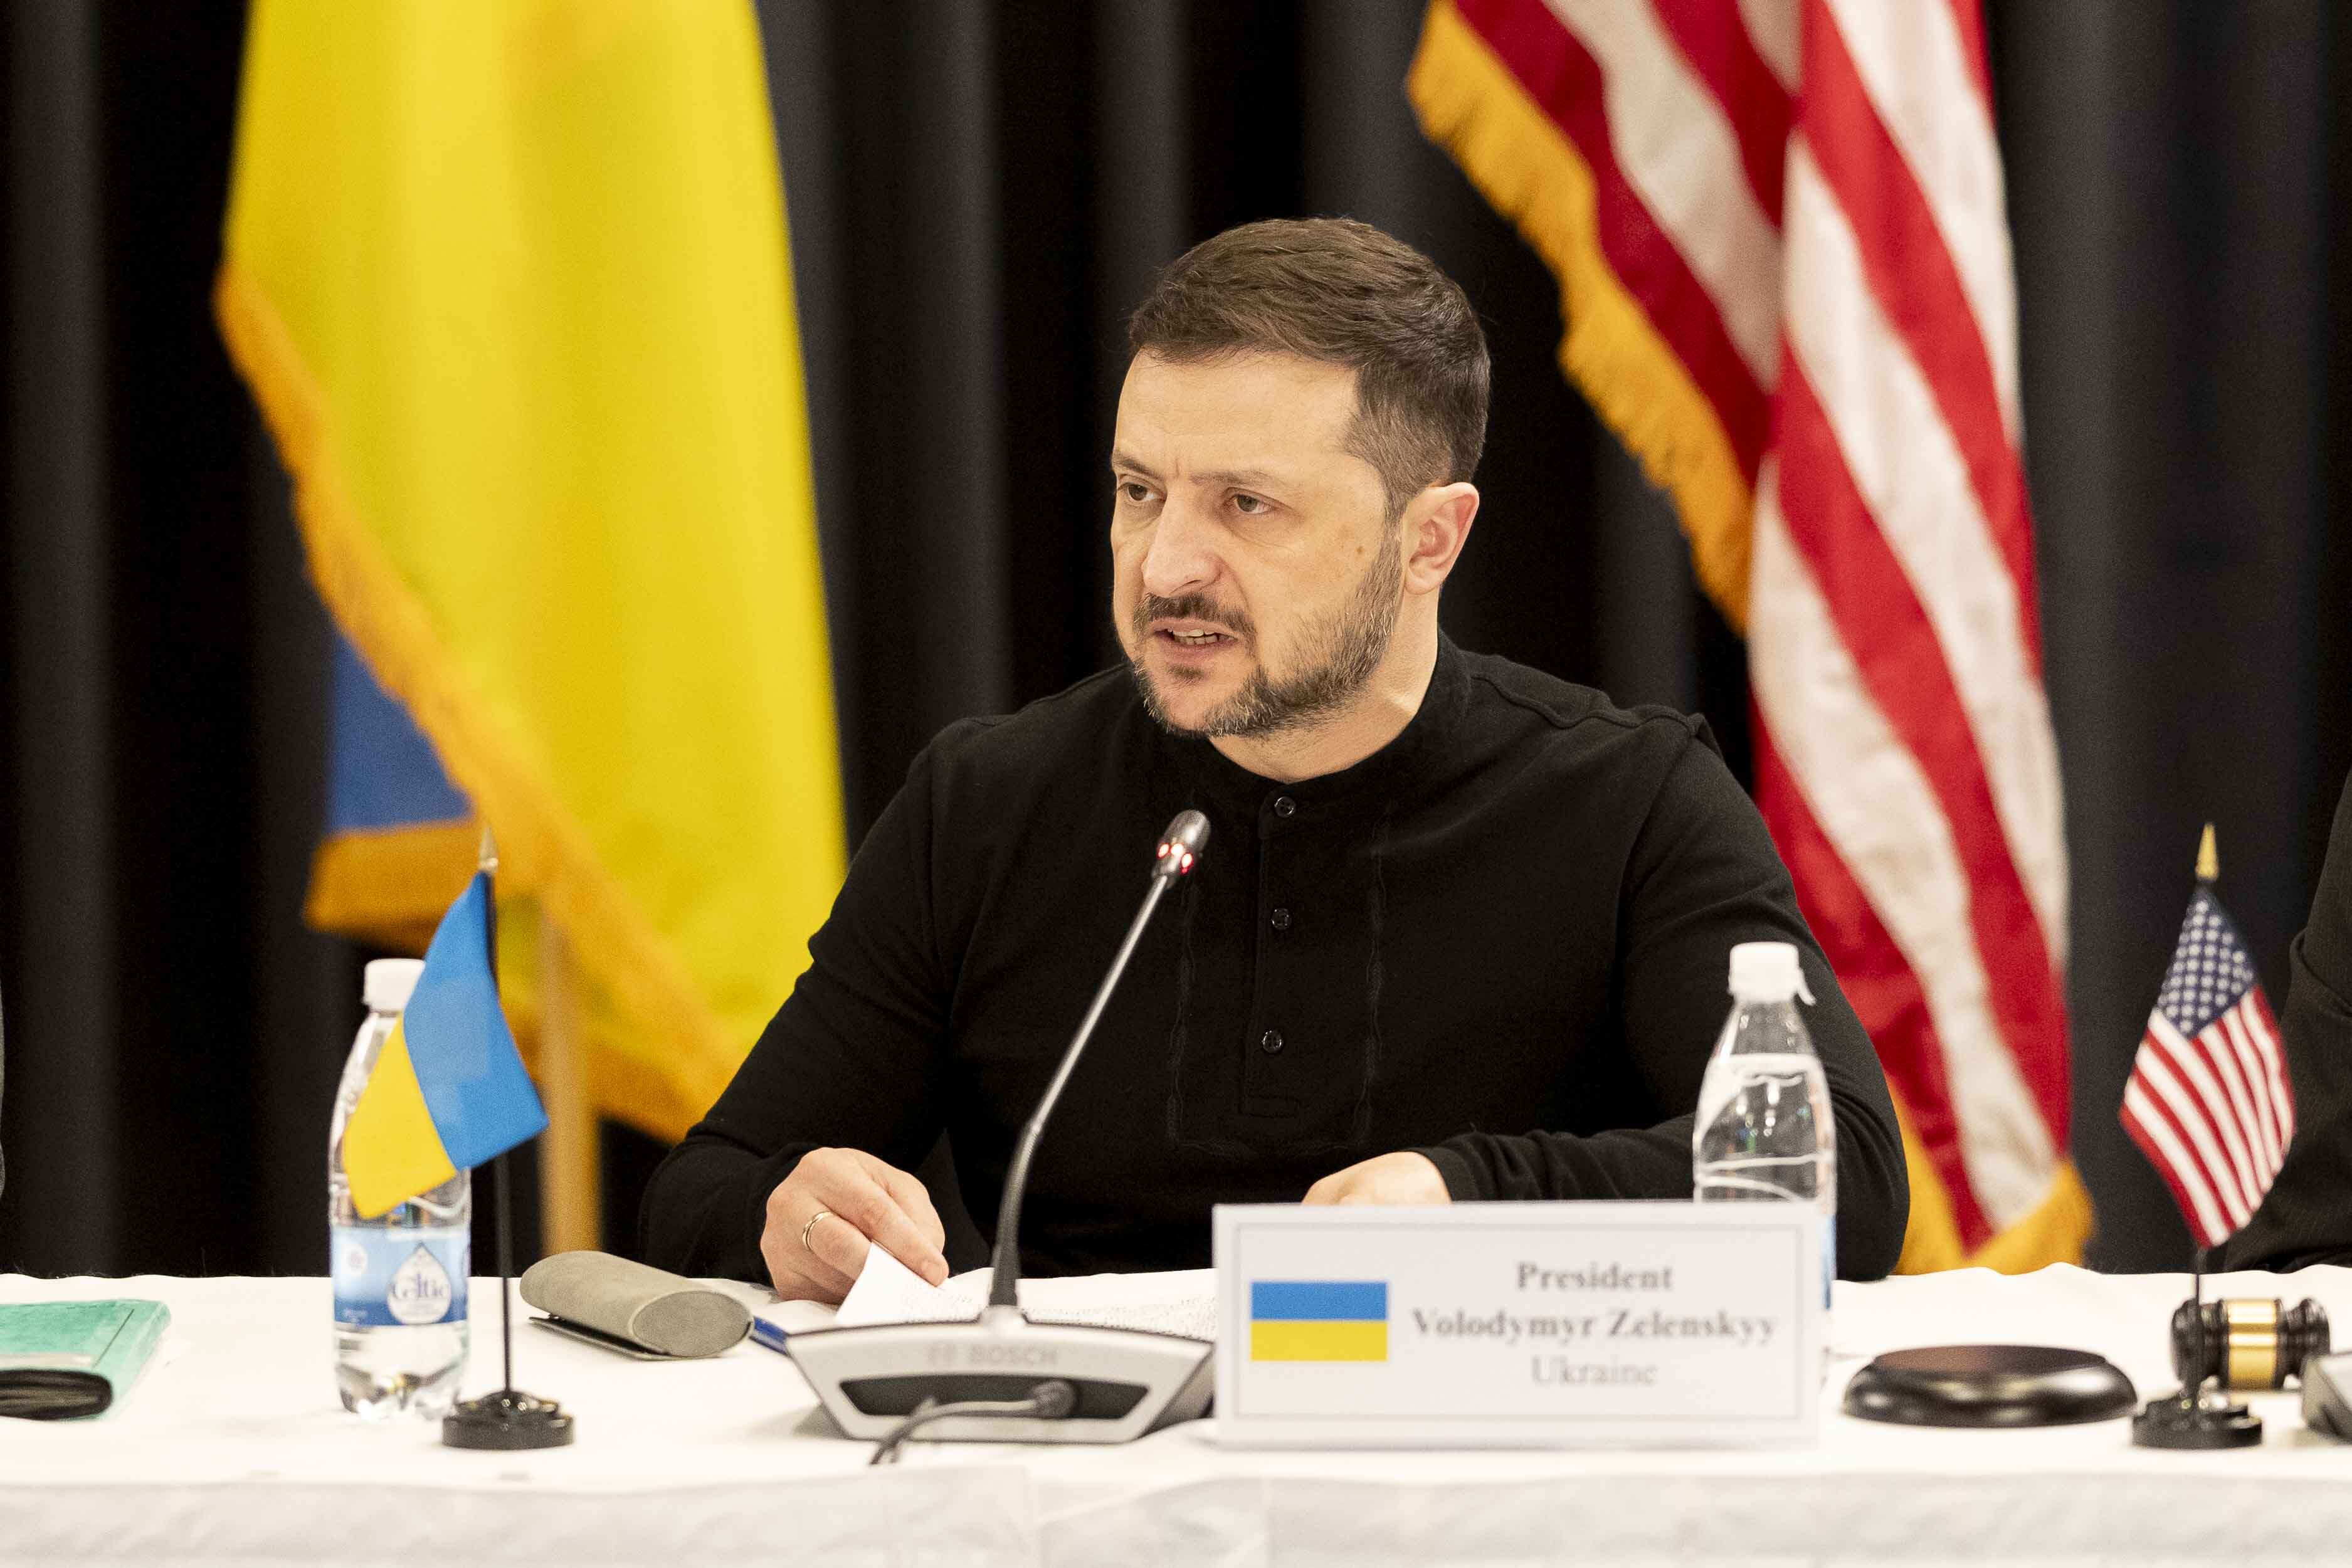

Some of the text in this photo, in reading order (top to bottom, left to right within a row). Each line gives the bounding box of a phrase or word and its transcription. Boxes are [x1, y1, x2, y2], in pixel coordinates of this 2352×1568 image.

[1517, 1261, 1674, 1290] President
[1411, 1307, 1777, 1347] Volodymyr Zelenskyy
[969, 1344, 1059, 1365] BOSCH
[1530, 1355, 1657, 1386] Ukraine
